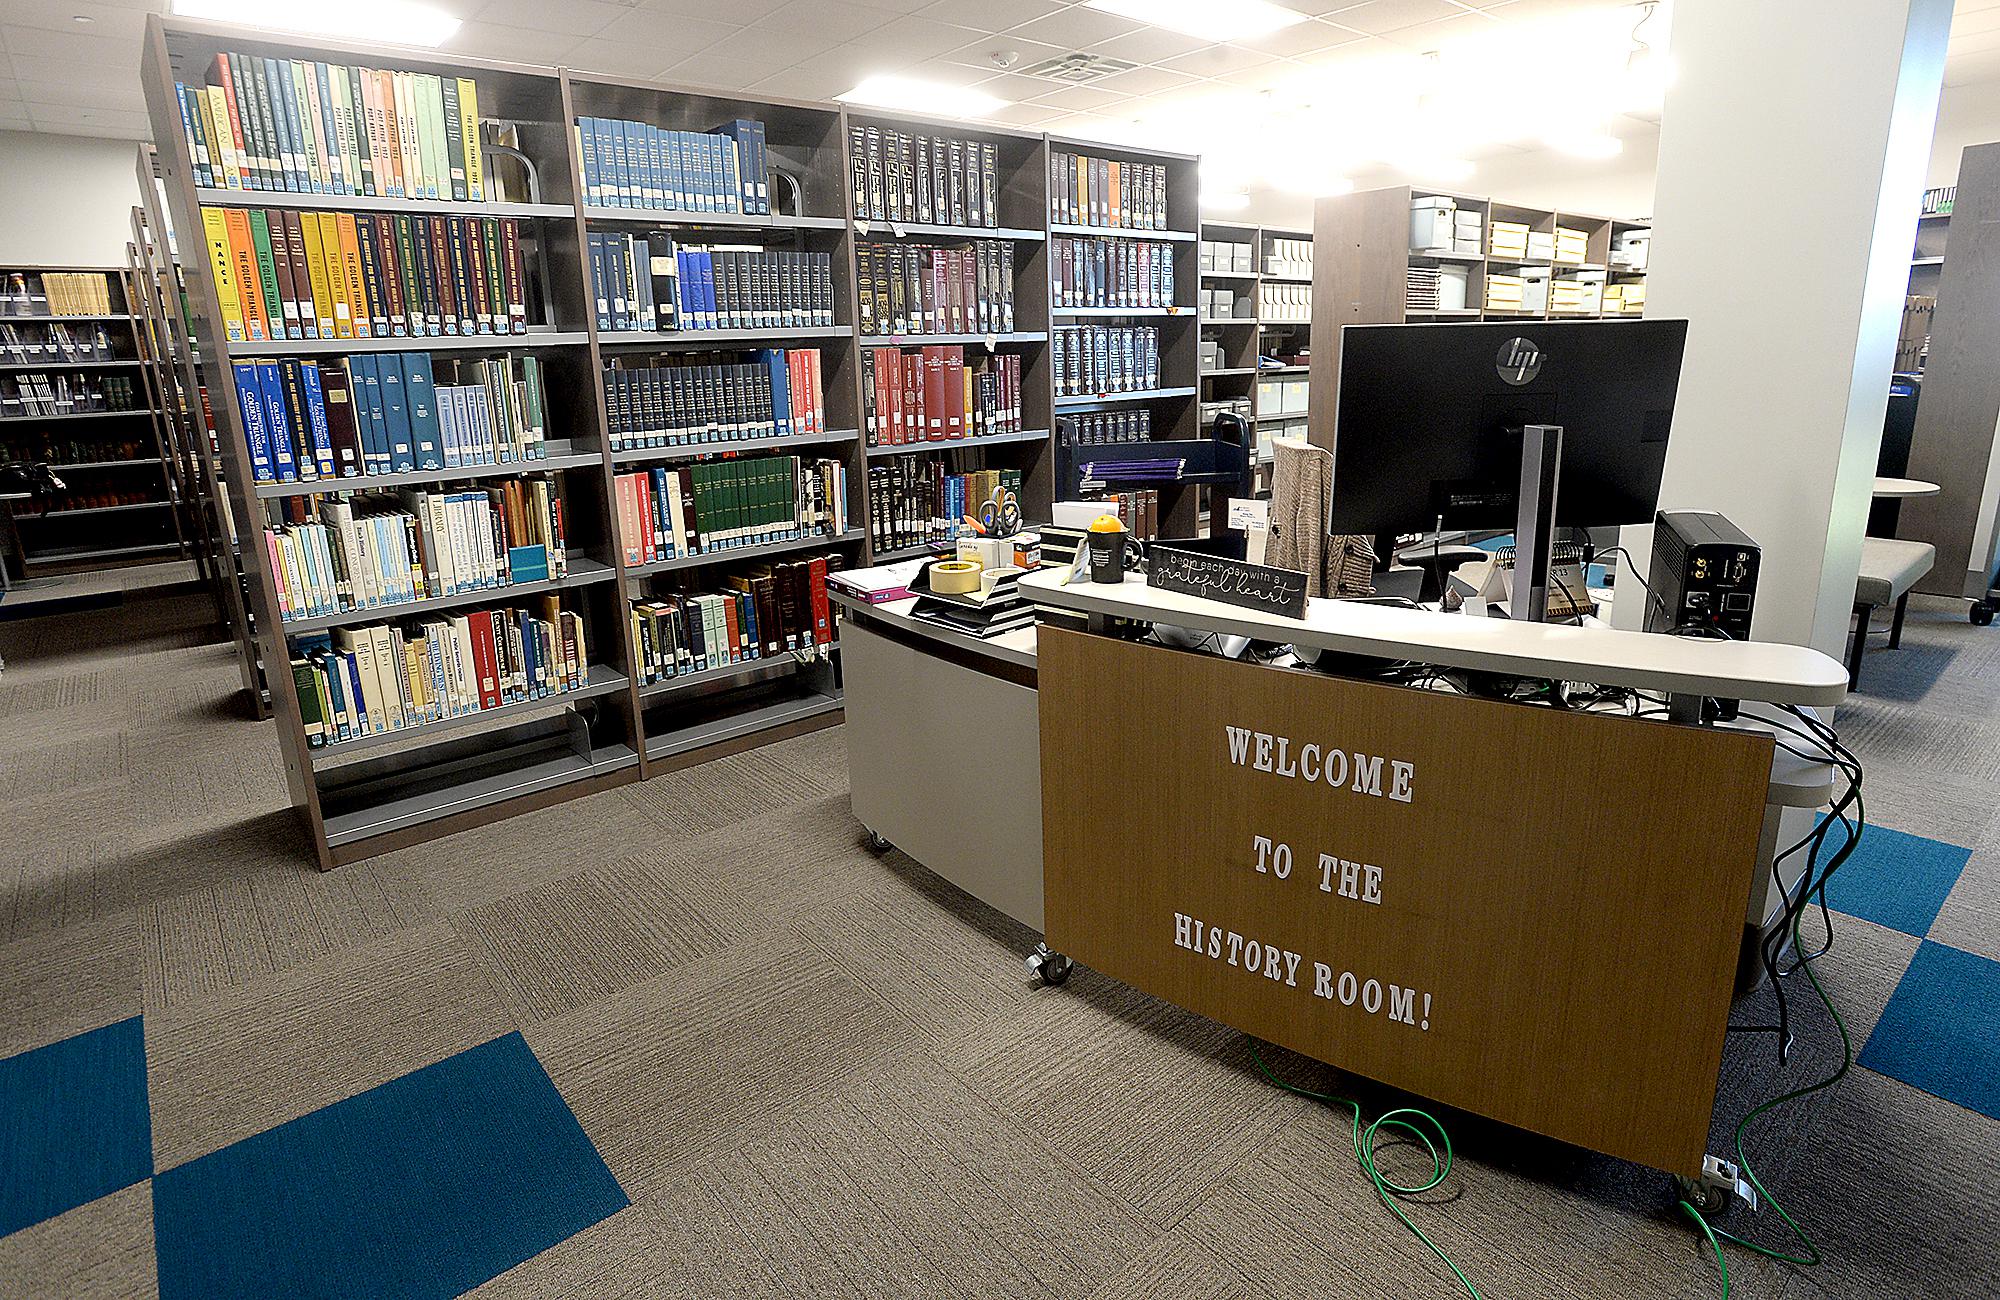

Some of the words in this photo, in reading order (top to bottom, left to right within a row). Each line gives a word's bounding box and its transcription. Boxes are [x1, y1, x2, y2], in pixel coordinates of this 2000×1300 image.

[215, 242, 228, 285] NANCE
[239, 251, 247, 262] THE
[259, 251, 267, 263] THE
[312, 253, 320, 263] THE
[346, 252, 355, 263] THE
[242, 265, 252, 289] GOLDEN
[262, 265, 271, 289] GOLDEN
[313, 266, 323, 289] GOLDEN
[332, 266, 340, 289] GOLDEN
[349, 266, 360, 289] GOLDEN
[248, 291, 259, 320] TRIANGLE
[317, 292, 328, 318] TRIANGL
[353, 291, 365, 319] TRIANGLE
[1507, 338, 1539, 380] hp
[246, 392, 257, 420] GOLDEN
[252, 421, 263, 455] TRIANGLE
[432, 500, 445, 534] LIBRARY
[1170, 554, 1198, 568] begin
[1200, 561, 1224, 573] each
[1228, 565, 1246, 577] day
[1250, 570, 1270, 583] with
[1274, 575, 1280, 584] a
[1156, 563, 1232, 596] grateful
[1236, 572, 1300, 605] heart
[494, 615, 502, 636] COUNTY
[454, 651, 462, 667] Records
[1225, 725, 1414, 803] WELCOME
[1253, 834, 1293, 879] TO
[1317, 852, 1383, 905] THE
[1174, 912, 1301, 987] HISTORY
[1313, 961, 1433, 1031] ROOM!
